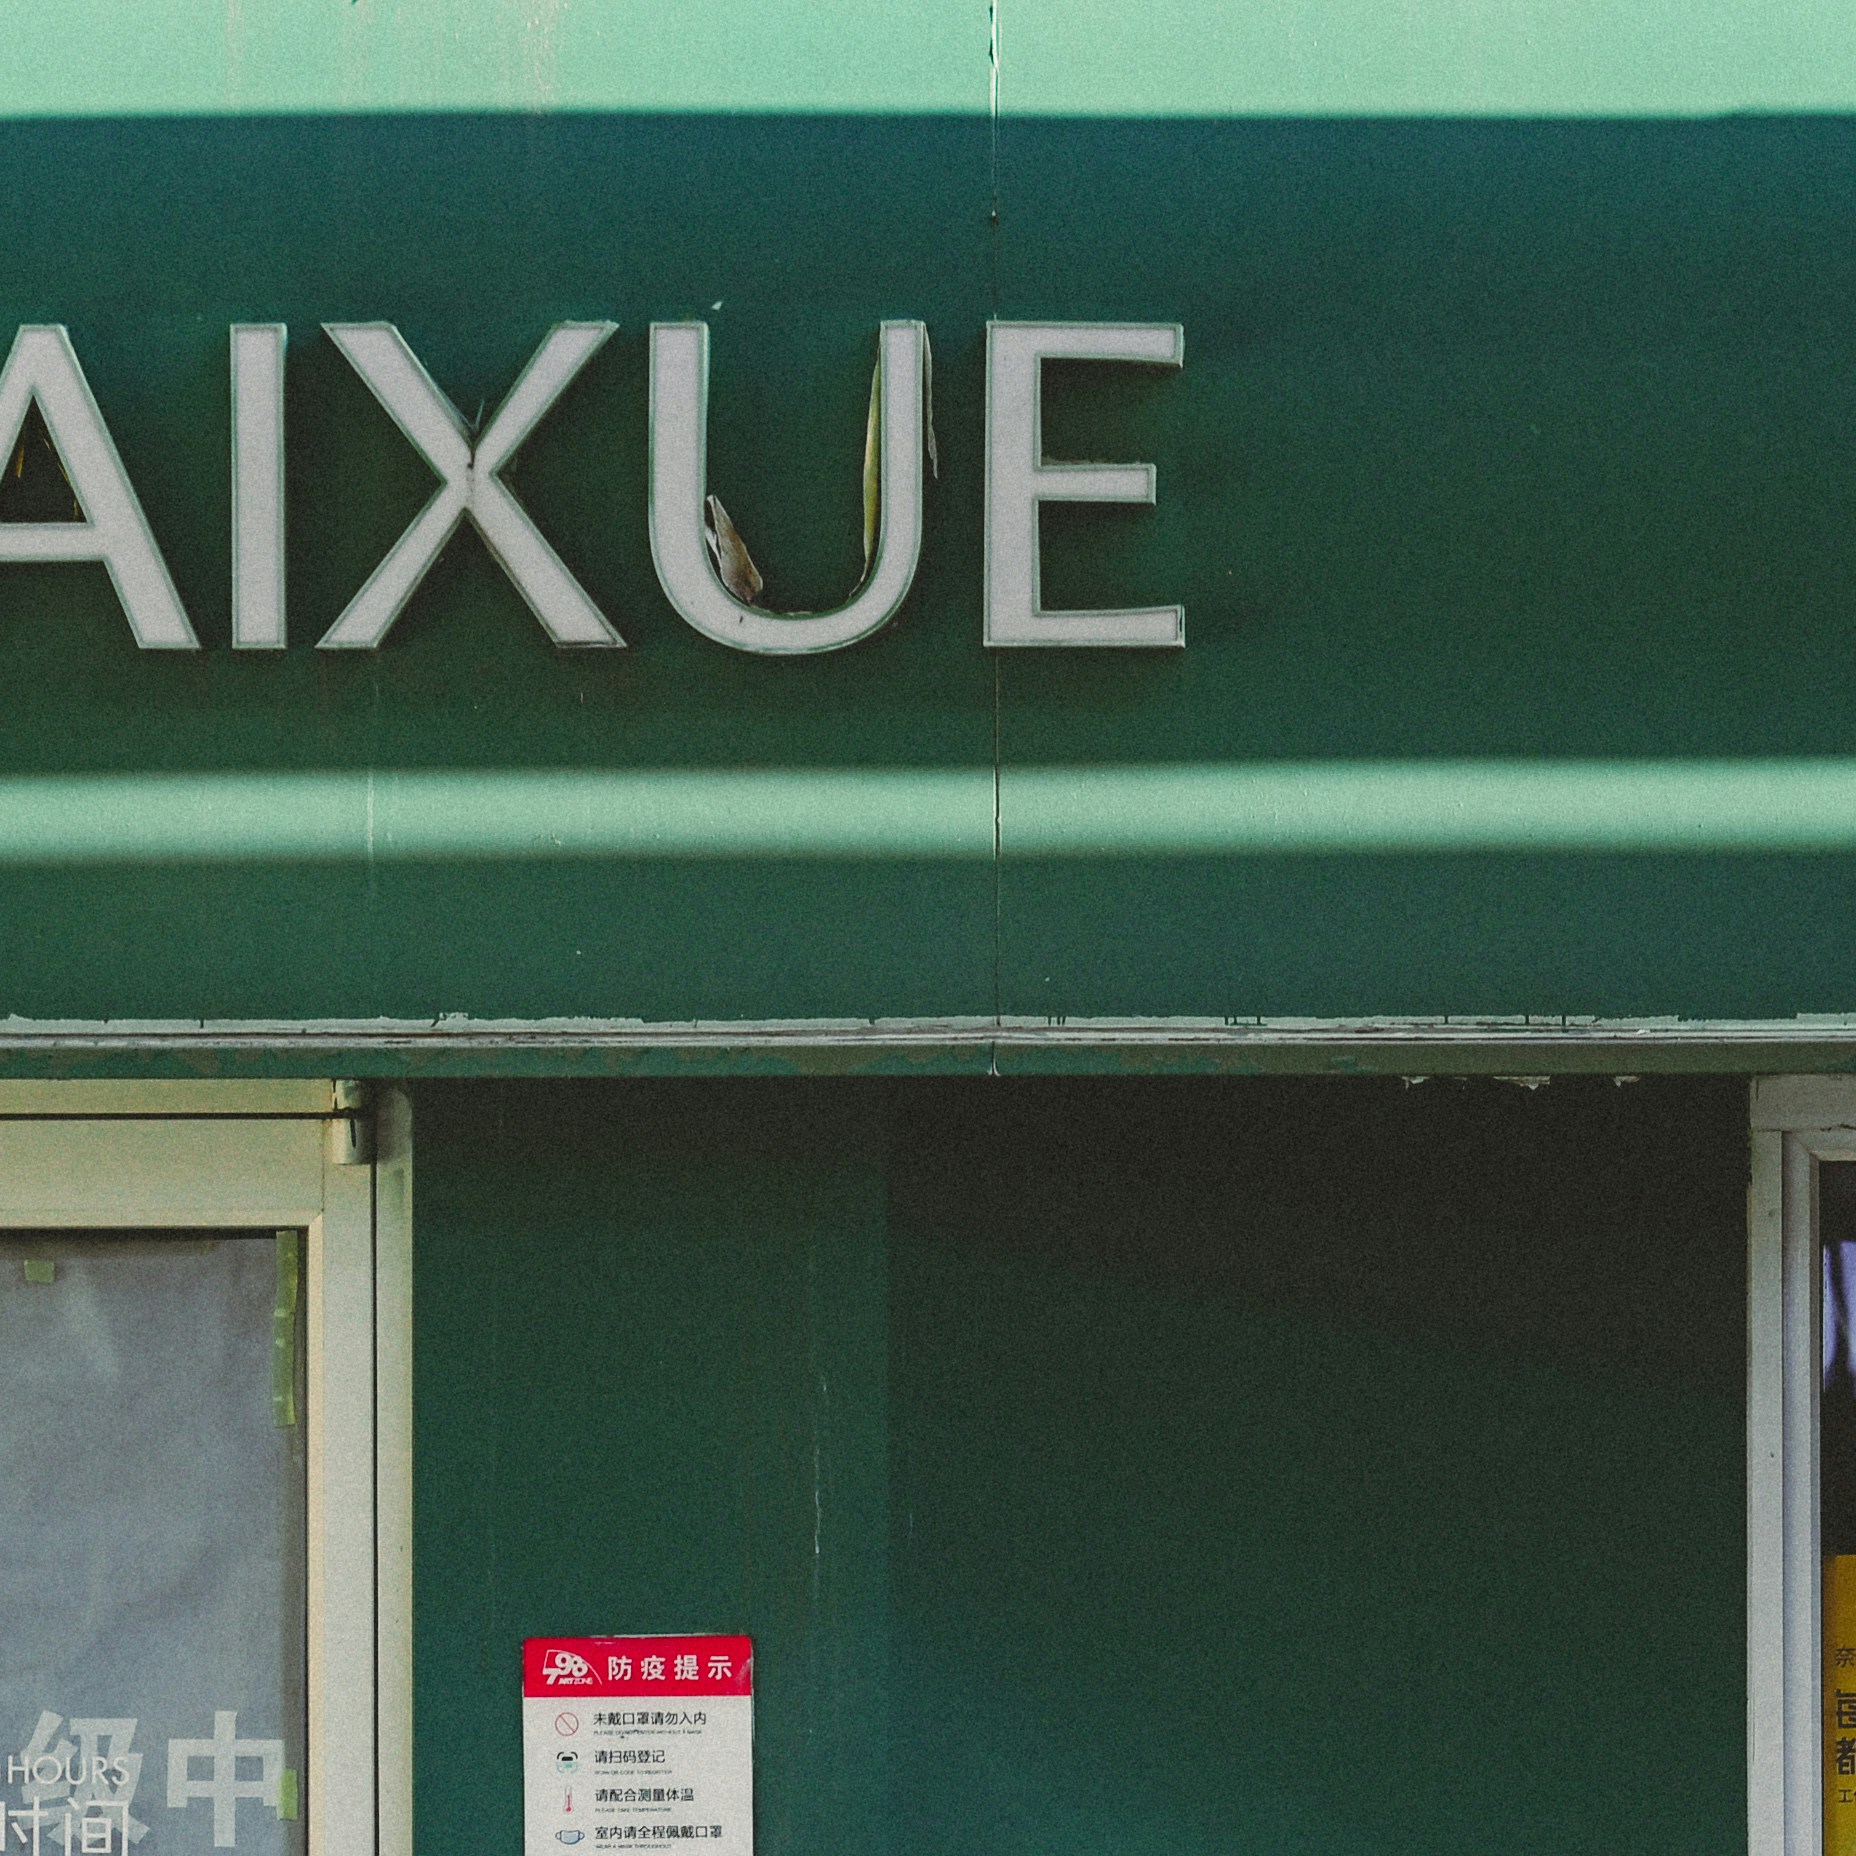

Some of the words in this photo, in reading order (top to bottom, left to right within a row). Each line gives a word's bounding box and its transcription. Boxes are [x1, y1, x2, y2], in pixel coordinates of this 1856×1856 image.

[607, 1655, 732, 1681] 防疫提示
[593, 1711, 706, 1725] 未戴口罩请勿入内
[595, 1750, 666, 1764] 请扫码登记
[7, 1755, 131, 1786] HOURS
[595, 1788, 694, 1802] 请配合测量体温
[595, 1825, 722, 1839] 室内请全程佩戴口罩
